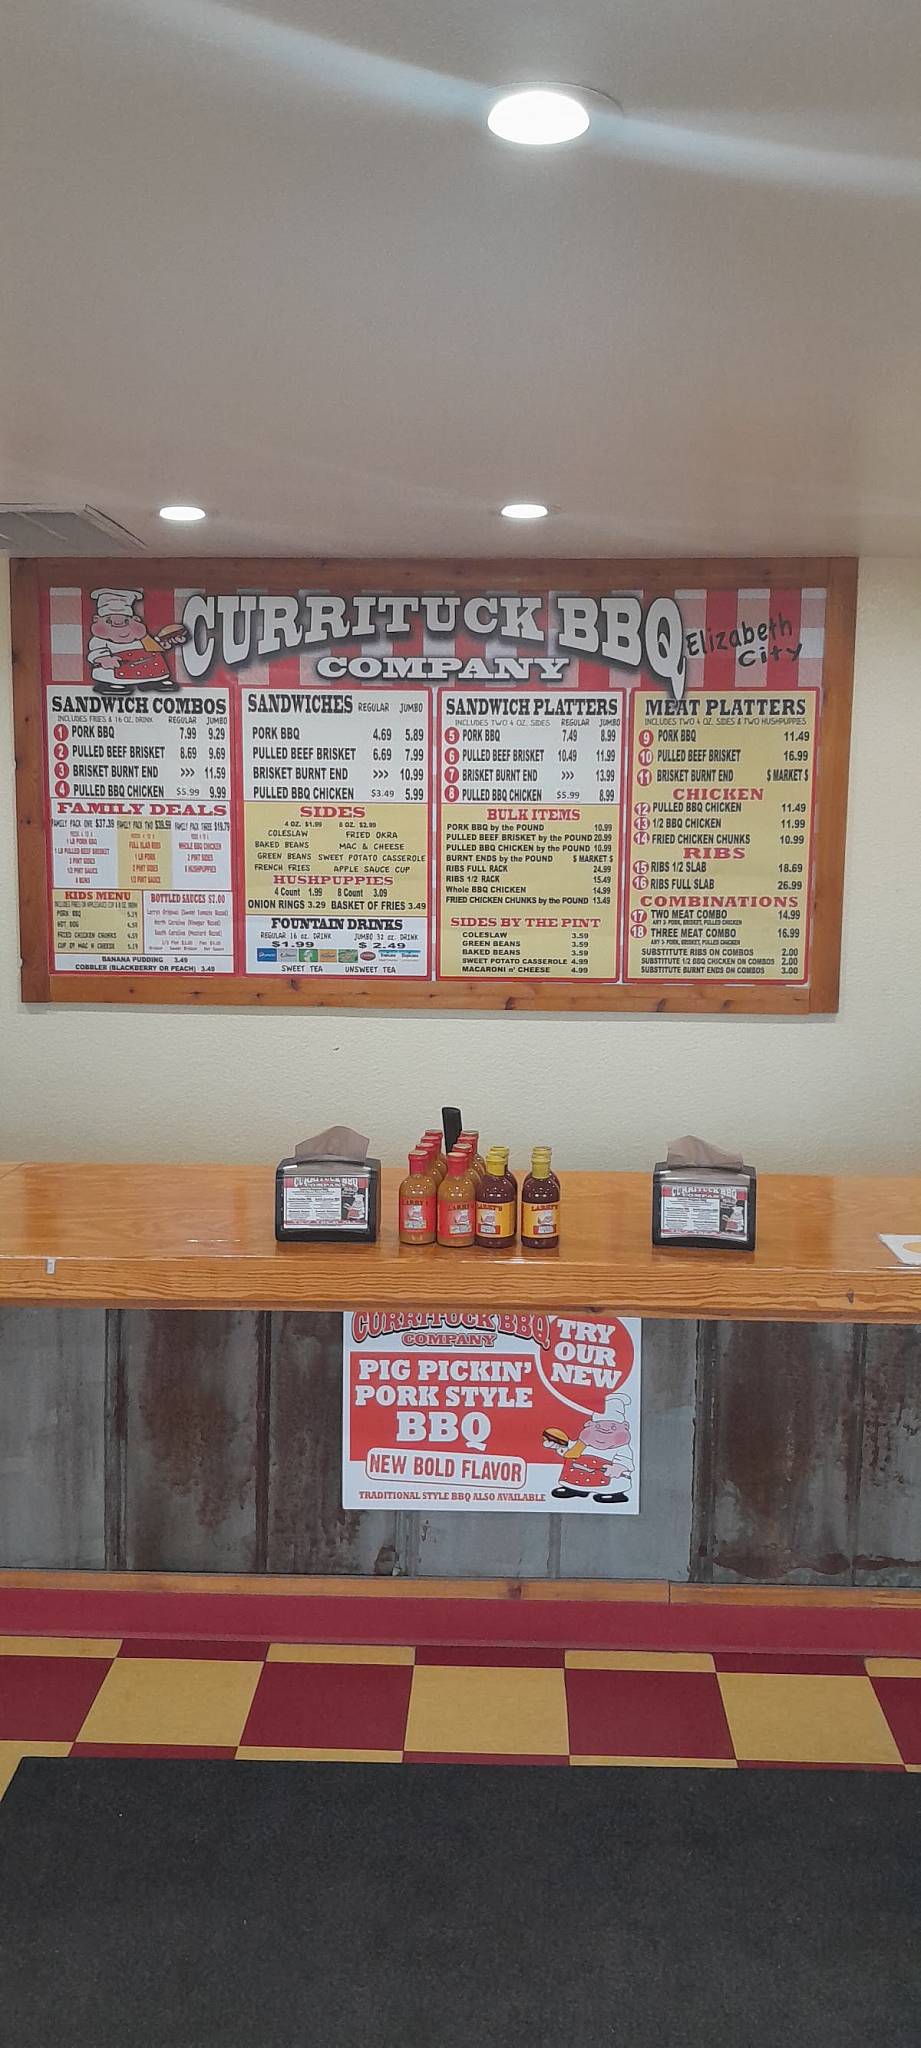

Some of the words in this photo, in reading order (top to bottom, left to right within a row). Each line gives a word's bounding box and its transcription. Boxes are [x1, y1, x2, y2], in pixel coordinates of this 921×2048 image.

[686, 619, 793, 657] Elizabeth
[181, 594, 544, 677] CURRITUCK
[557, 597, 686, 699] BBQ
[737, 643, 803, 669] City
[317, 656, 570, 680] COMPANY
[52, 696, 148, 712] SANDWICH
[152, 698, 226, 714] COMBOS
[248, 694, 352, 713] SANDWICHES
[358, 702, 389, 712] REGULAR
[400, 703, 422, 713] JUMBO
[446, 698, 532, 715] SANDWICH
[534, 699, 617, 715] PLATTERS
[646, 699, 700, 715] MEAT
[705, 699, 806, 715] PLATTERS
[168, 716, 196, 724] REGULAR
[599, 719, 620, 727] JUMBO
[58, 728, 63, 738] 1
[72, 726, 95, 738] PORK
[98, 726, 114, 738] BBQ
[180, 727, 196, 739] 7.99
[208, 728, 225, 740] 9.29
[252, 727, 278, 739] PORK
[281, 727, 300, 740] BBQ
[373, 728, 391, 741] 4.69
[405, 729, 423, 741] 5.89
[449, 731, 455, 741] 5
[463, 729, 482, 741] PORK
[485, 730, 500, 742] BBQ
[562, 730, 577, 742] 7.49
[601, 730, 615, 742] 8.99
[643, 732, 649, 743] 9
[658, 729, 678, 742] PORK
[681, 730, 696, 742] BBQ
[784, 732, 809, 741] 11.49
[58, 747, 64, 757] 2
[72, 745, 104, 758] PULLED
[107, 746, 127, 758] BEEF
[130, 747, 165, 758] BRISKET
[180, 747, 196, 759] 8.69
[209, 748, 225, 759] 9.69
[253, 747, 288, 759] PULLED
[291, 748, 313, 760] BEEF
[317, 748, 356, 760] BRISKET
[373, 748, 391, 760] 6.69
[405, 749, 423, 761] 7.99
[449, 751, 455, 761] 6
[462, 750, 490, 762] PULLED
[493, 750, 511, 761] BEEF
[513, 750, 544, 762] BRISKET
[558, 750, 577, 762] 10.49
[596, 750, 615, 762] 11.99
[58, 766, 64, 777] 3
[73, 765, 108, 777] BRISKET
[111, 766, 139, 777] BURNT
[142, 766, 158, 778] END
[205, 767, 226, 779] 11.59
[638, 771, 650, 782] 11
[657, 769, 688, 781] BRISKET
[691, 770, 716, 781] BURNT
[718, 770, 733, 781] END
[59, 784, 65, 795] 4
[74, 784, 105, 796] PULLED
[108, 785, 125, 797] BBQ
[128, 785, 164, 797] CHICKEN
[209, 787, 226, 798] 9.99
[672, 788, 764, 800] CHICKEN
[58, 802, 144, 815] FAMILY
[150, 804, 226, 816] DEALS
[300, 807, 365, 818] SIDES
[487, 809, 528, 820] BULK
[532, 809, 580, 821] ITEMS
[490, 824, 499, 832] by
[636, 819, 648, 829] 13
[653, 818, 663, 828] 1/2
[666, 818, 682, 828] BBQ
[685, 818, 721, 828] CHICKEN
[781, 819, 805, 828] 11.99
[683, 848, 745, 859] RIBS
[273, 875, 393, 885] HUSHPUPPIES
[635, 878, 647, 888] 16
[651, 879, 669, 889] RIBS
[672, 879, 691, 889] FULL
[693, 879, 714, 889] SLAB
[778, 881, 802, 890] 26.99
[65, 892, 93, 900] KIDS
[96, 892, 131, 900] MENU
[640, 896, 798, 907] COMBINATIONS
[248, 900, 276, 908] ONION
[278, 900, 304, 909] RINGS
[331, 901, 364, 910] BASKET
[368, 901, 379, 910] OF
[381, 902, 405, 910] FRIES
[633, 911, 645, 921] 17
[651, 910, 669, 919] TWO
[672, 910, 694, 919] MEAT
[697, 910, 727, 919] COMBO
[778, 910, 800, 919] 14.99
[271, 918, 344, 929] FOUNTAIN
[347, 919, 402, 930] DRINKS
[451, 918, 497, 927] SIDES
[500, 918, 521, 927] BY
[525, 919, 558, 927] THE
[562, 919, 601, 928] PINT
[498, 1313, 550, 1351] BBQ
[556, 1319, 615, 1344] TRY
[402, 1333, 496, 1347] COMPANY
[554, 1342, 616, 1367] OUR
[358, 1360, 410, 1380] PIG
[418, 1360, 532, 1382] PICKIN'
[551, 1362, 622, 1390] NEW
[355, 1386, 440, 1406] PORK
[446, 1386, 533, 1408] STYLE
[396, 1412, 491, 1451] BBQ
[370, 1453, 410, 1474] NEW
[414, 1457, 455, 1478] BOLD
[462, 1460, 522, 1482] FLAVOR
[359, 1491, 420, 1500] TRADITIONAL
[422, 1492, 450, 1501] STYLE
[452, 1492, 471, 1502] BBQ
[473, 1492, 495, 1501] ALSO
[496, 1492, 546, 1502] AVAILABLE
